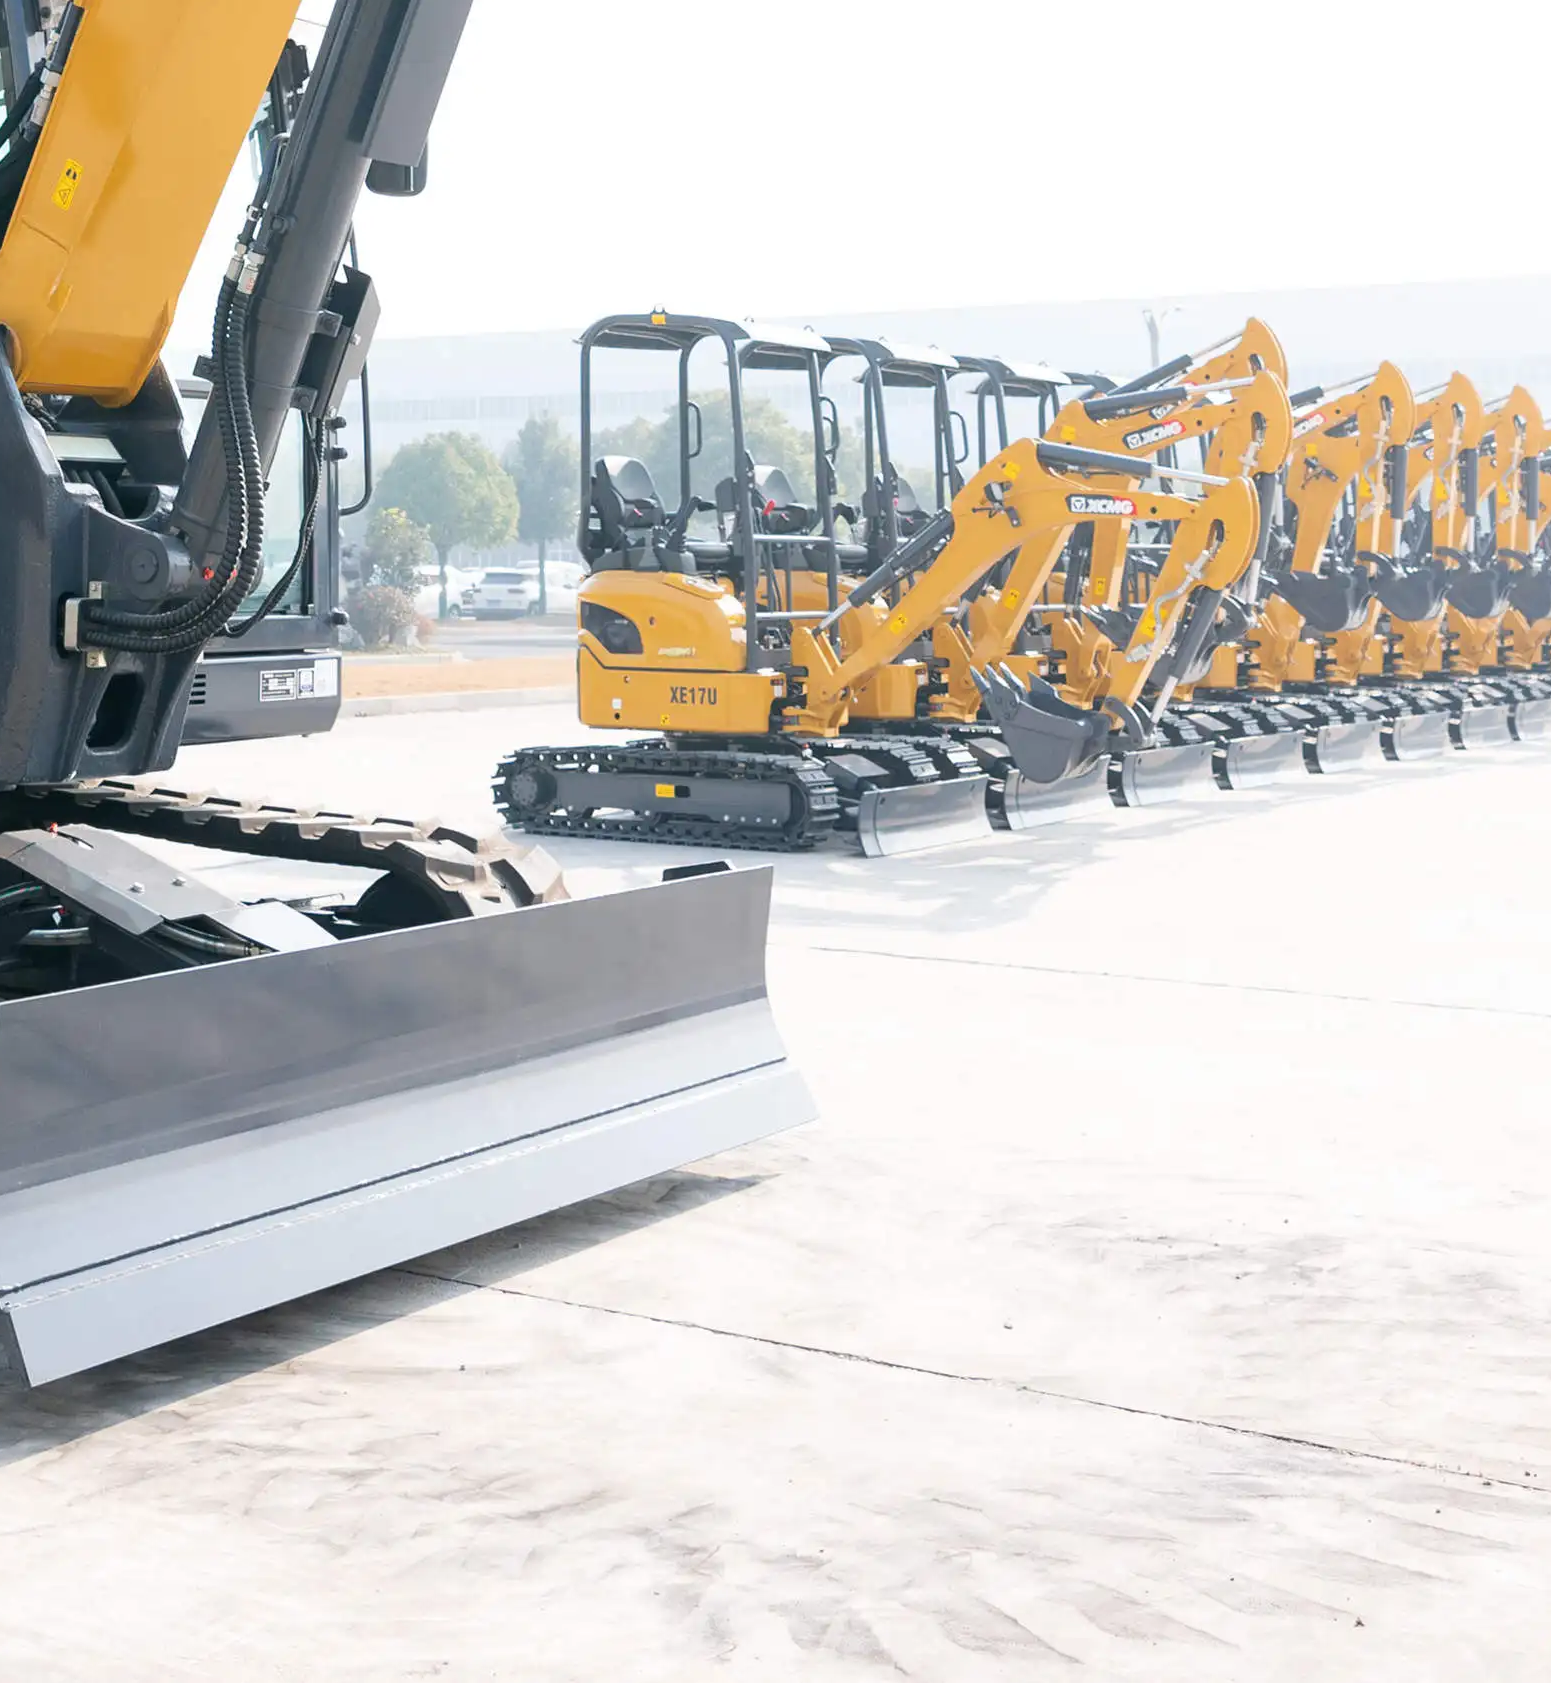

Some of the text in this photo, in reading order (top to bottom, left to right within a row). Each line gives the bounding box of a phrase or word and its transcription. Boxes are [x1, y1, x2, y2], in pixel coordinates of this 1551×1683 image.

[1140, 421, 1183, 444] XCMG
[1086, 498, 1134, 515] XCMG
[670, 686, 717, 705] XE17U
